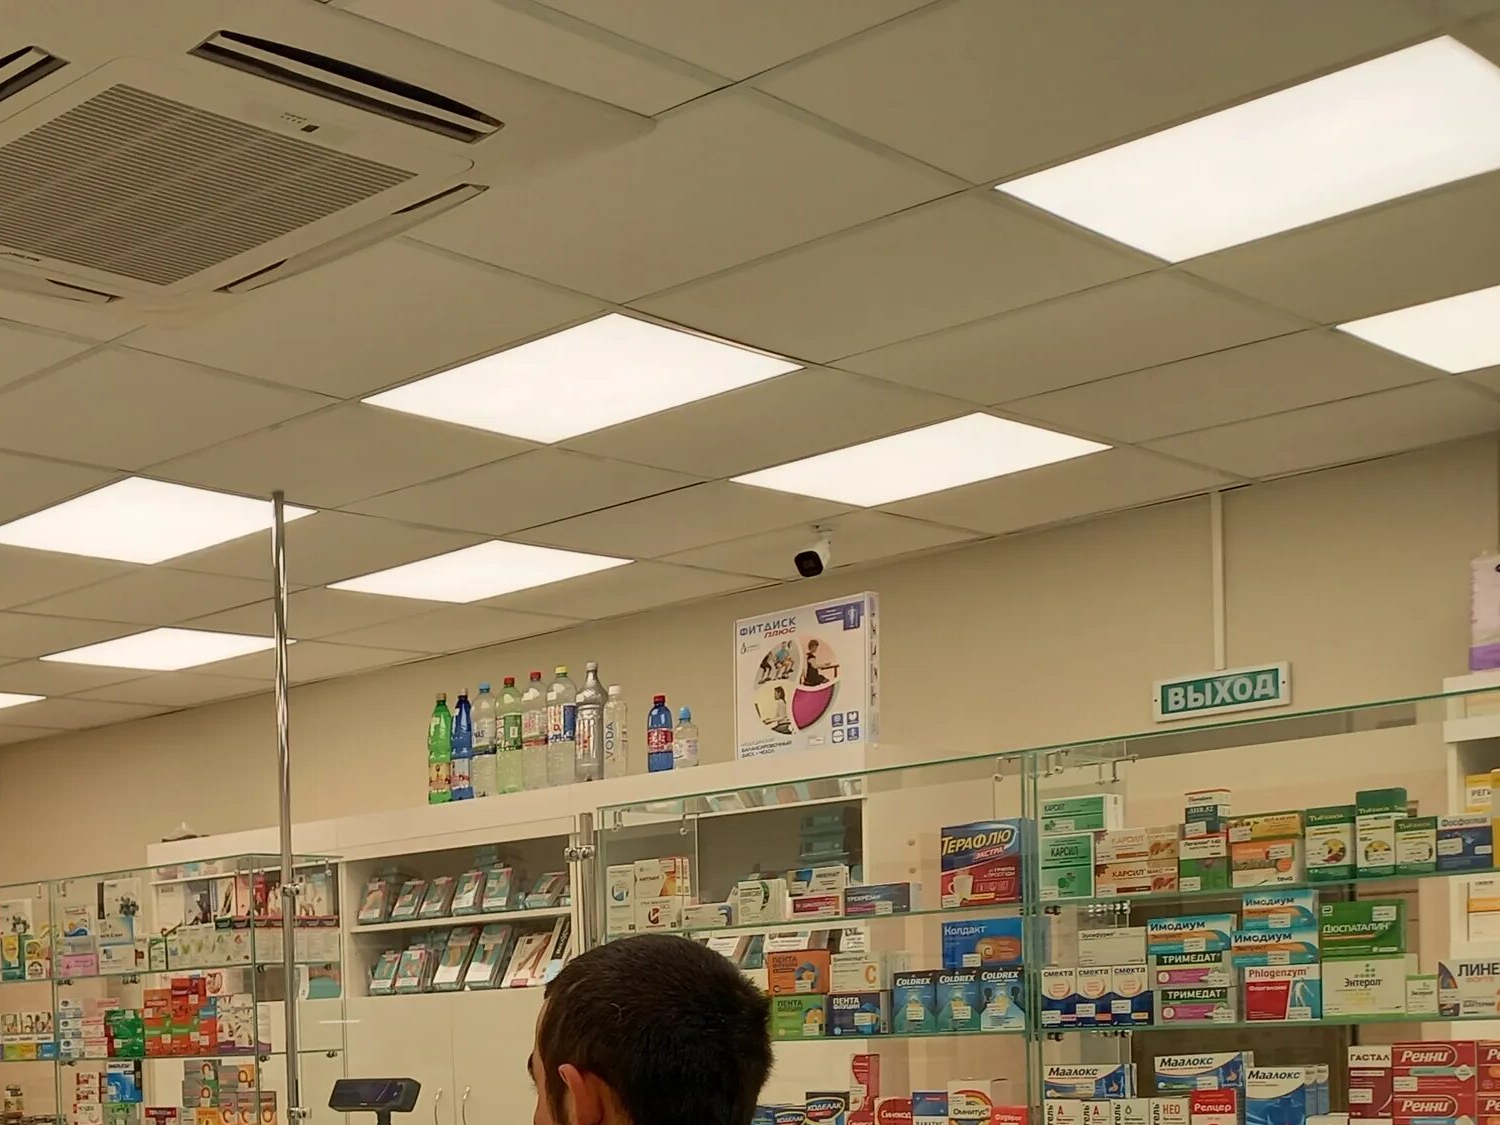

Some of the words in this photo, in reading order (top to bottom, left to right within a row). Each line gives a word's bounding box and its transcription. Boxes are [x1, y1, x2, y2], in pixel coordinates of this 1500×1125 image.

[764, 626, 797, 638] ПЛЮС
[1167, 673, 1276, 711] ВЫХОД
[605, 721, 614, 760] VODA
[1043, 803, 1066, 812] КАРСИЛ
[941, 829, 1012, 857] ТЕРАФЛЮ
[1050, 845, 1079, 857] КАРСИЛ
[1112, 867, 1145, 878] КАРСИЛ
[1245, 895, 1296, 907] Имодиум
[944, 925, 987, 937] Колдакт
[1150, 921, 1206, 932] Имодиум
[1322, 922, 1389, 933] ДЮСПАТАЛИН
[1234, 931, 1293, 943] Имодиум
[1162, 953, 1216, 964] ТРИМЕДАТ
[981, 971, 1018, 982] COLDREX
[1043, 969, 1074, 979] смекта
[1078, 968, 1109, 977] смекта
[1114, 966, 1146, 976] смекта
[1248, 968, 1307, 980] Phlogenzym
[896, 976, 932, 986] COLDREX
[939, 973, 975, 984] COLDREX
[1344, 977, 1381, 990] Энтерол
[1167, 988, 1223, 1000] ТРИМЕДАТ
[833, 996, 860, 1005] ПЕНТА
[1160, 1056, 1213, 1068] Маалокс
[1350, 1053, 1390, 1062] ГАСТАЛ
[1401, 1050, 1449, 1063] Ренни
[1048, 1066, 1098, 1078] Маалокс
[1247, 1070, 1301, 1081] Маалокс
[807, 1101, 842, 1112] КОДЕЛАК
[1162, 1104, 1181, 1114] НЕО
[1194, 1102, 1232, 1113] Релцер
[1401, 1099, 1449, 1112] Ренни
[953, 1108, 989, 1117] Омнитус
